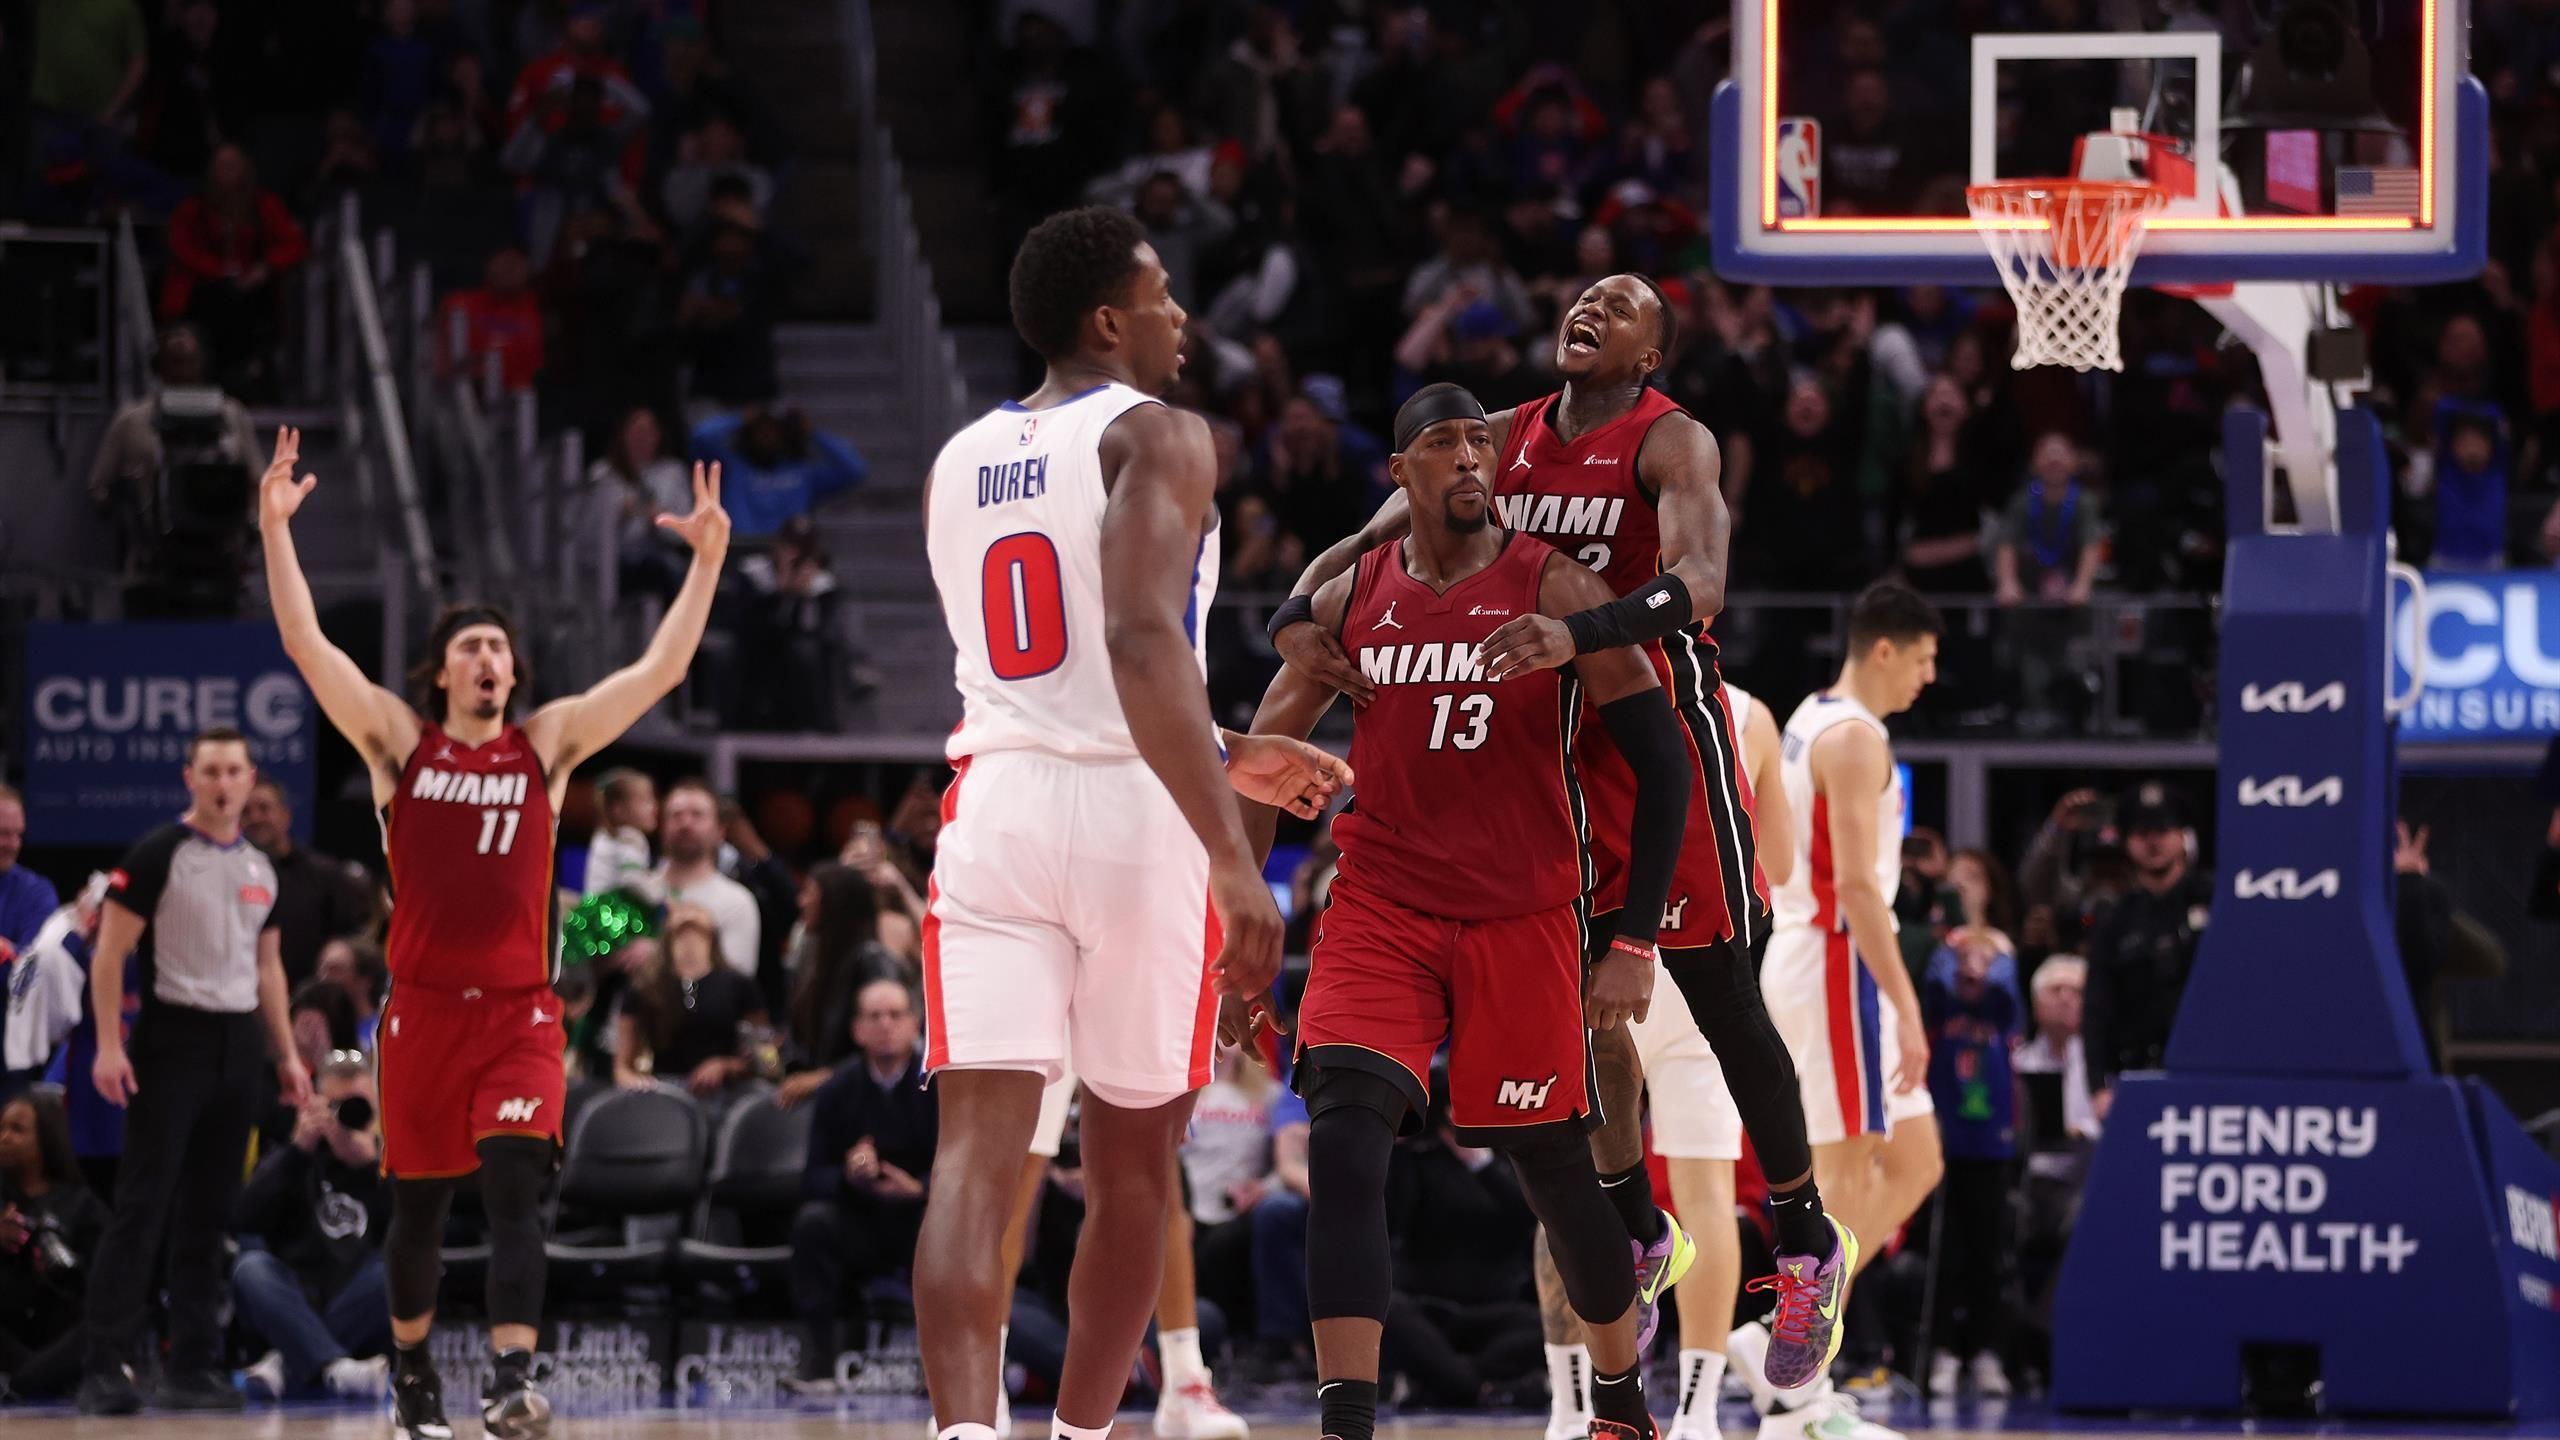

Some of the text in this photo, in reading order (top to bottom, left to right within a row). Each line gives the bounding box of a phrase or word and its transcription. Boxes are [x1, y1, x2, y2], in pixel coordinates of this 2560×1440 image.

[978, 453, 1049, 508] DUREN
[1494, 493, 1625, 536] MIAMI
[982, 531, 1068, 681] 0
[33, 675, 240, 733] CURE
[2241, 681, 2346, 713] KIA
[1428, 693, 1494, 750] 13
[34, 737, 115, 763] AUTO
[412, 766, 529, 806] MIAMI
[2238, 775, 2343, 807] KIA
[476, 808, 521, 856] 11
[2234, 868, 2339, 900] KIA
[2148, 1106, 2378, 1158] HENRY
[2160, 1163, 2328, 1214] FORD
[2160, 1221, 2419, 1274] HEALTH
[555, 1321, 650, 1361] Little
[707, 1322, 802, 1364] Little
